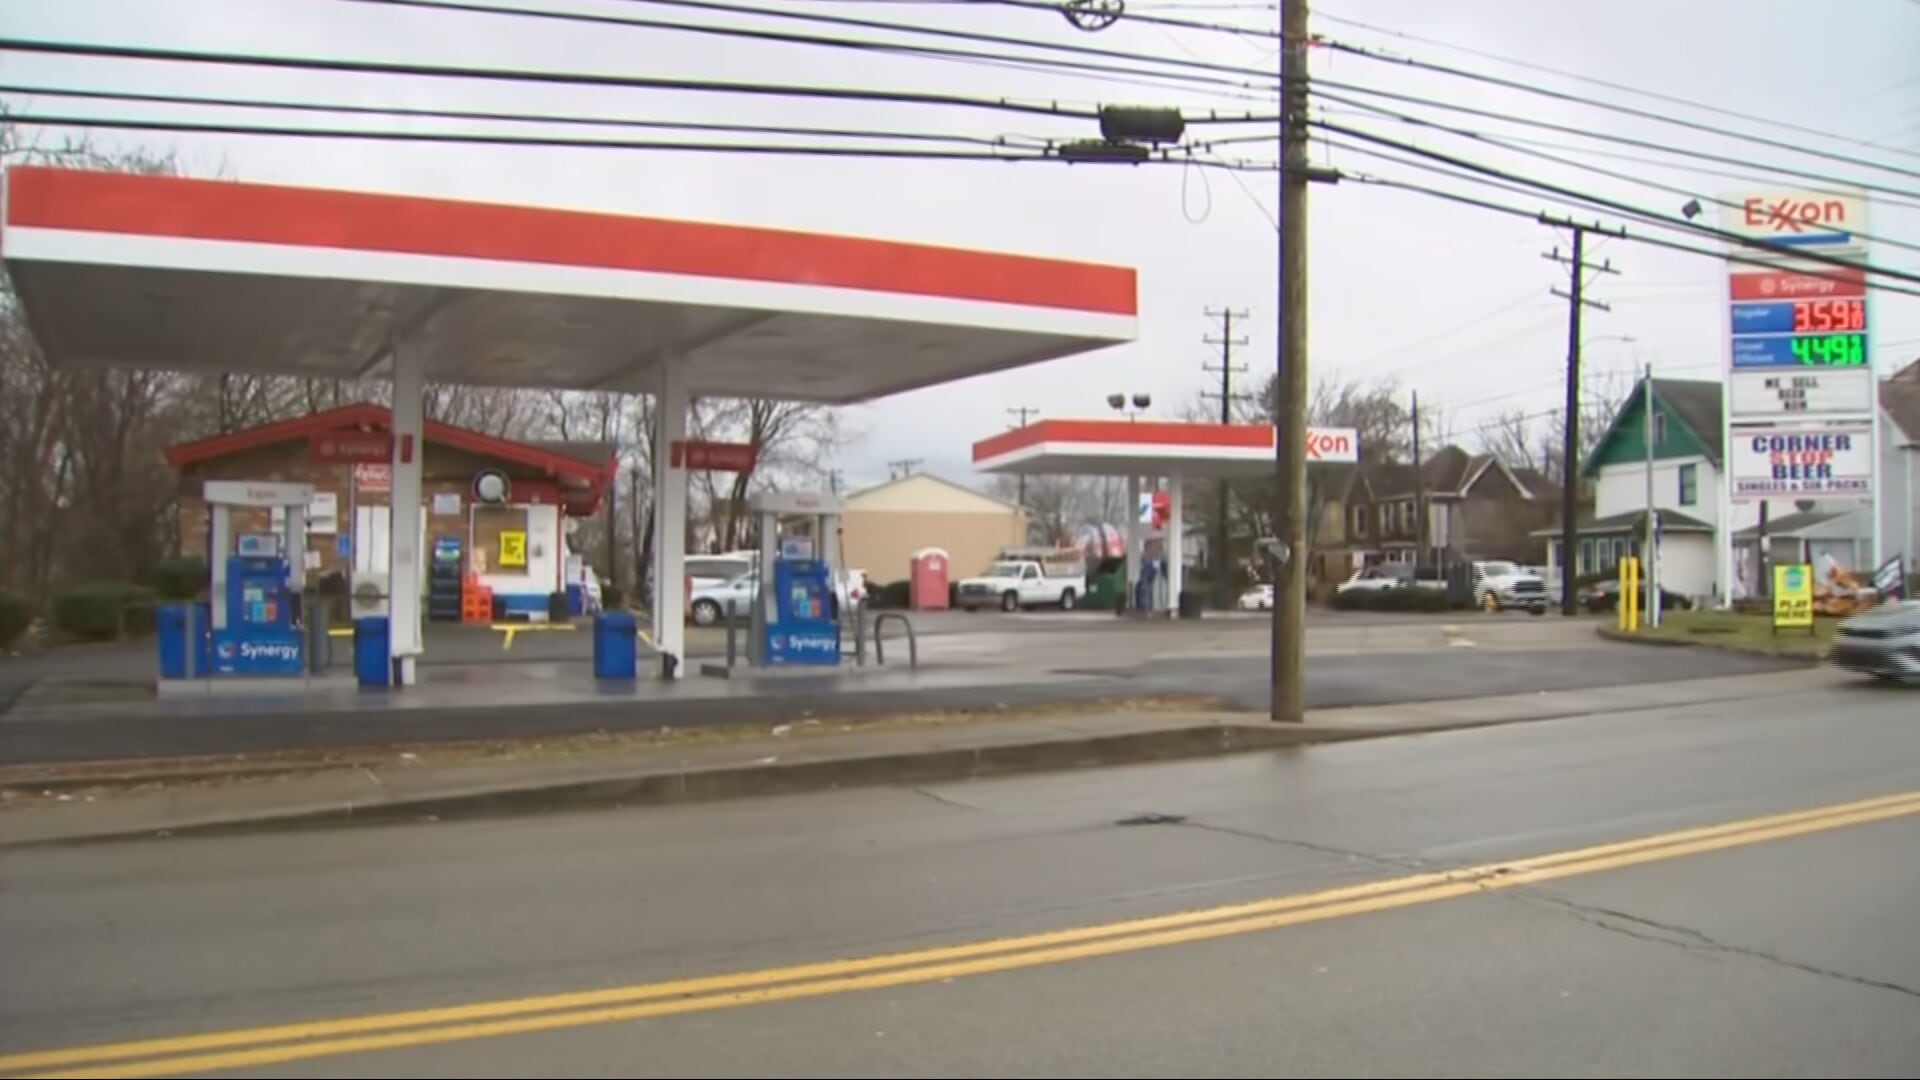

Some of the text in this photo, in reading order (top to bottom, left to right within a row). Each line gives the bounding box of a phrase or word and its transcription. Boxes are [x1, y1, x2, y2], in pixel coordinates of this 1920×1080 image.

[1744, 198, 1845, 232] Exxon
[1780, 278, 1836, 296] Synergy
[1752, 434, 1851, 453] CORNER
[1770, 450, 1833, 465] STOP
[1772, 464, 1831, 480] BEER
[241, 642, 299, 660] Synergy
[787, 634, 836, 652] Synergy
